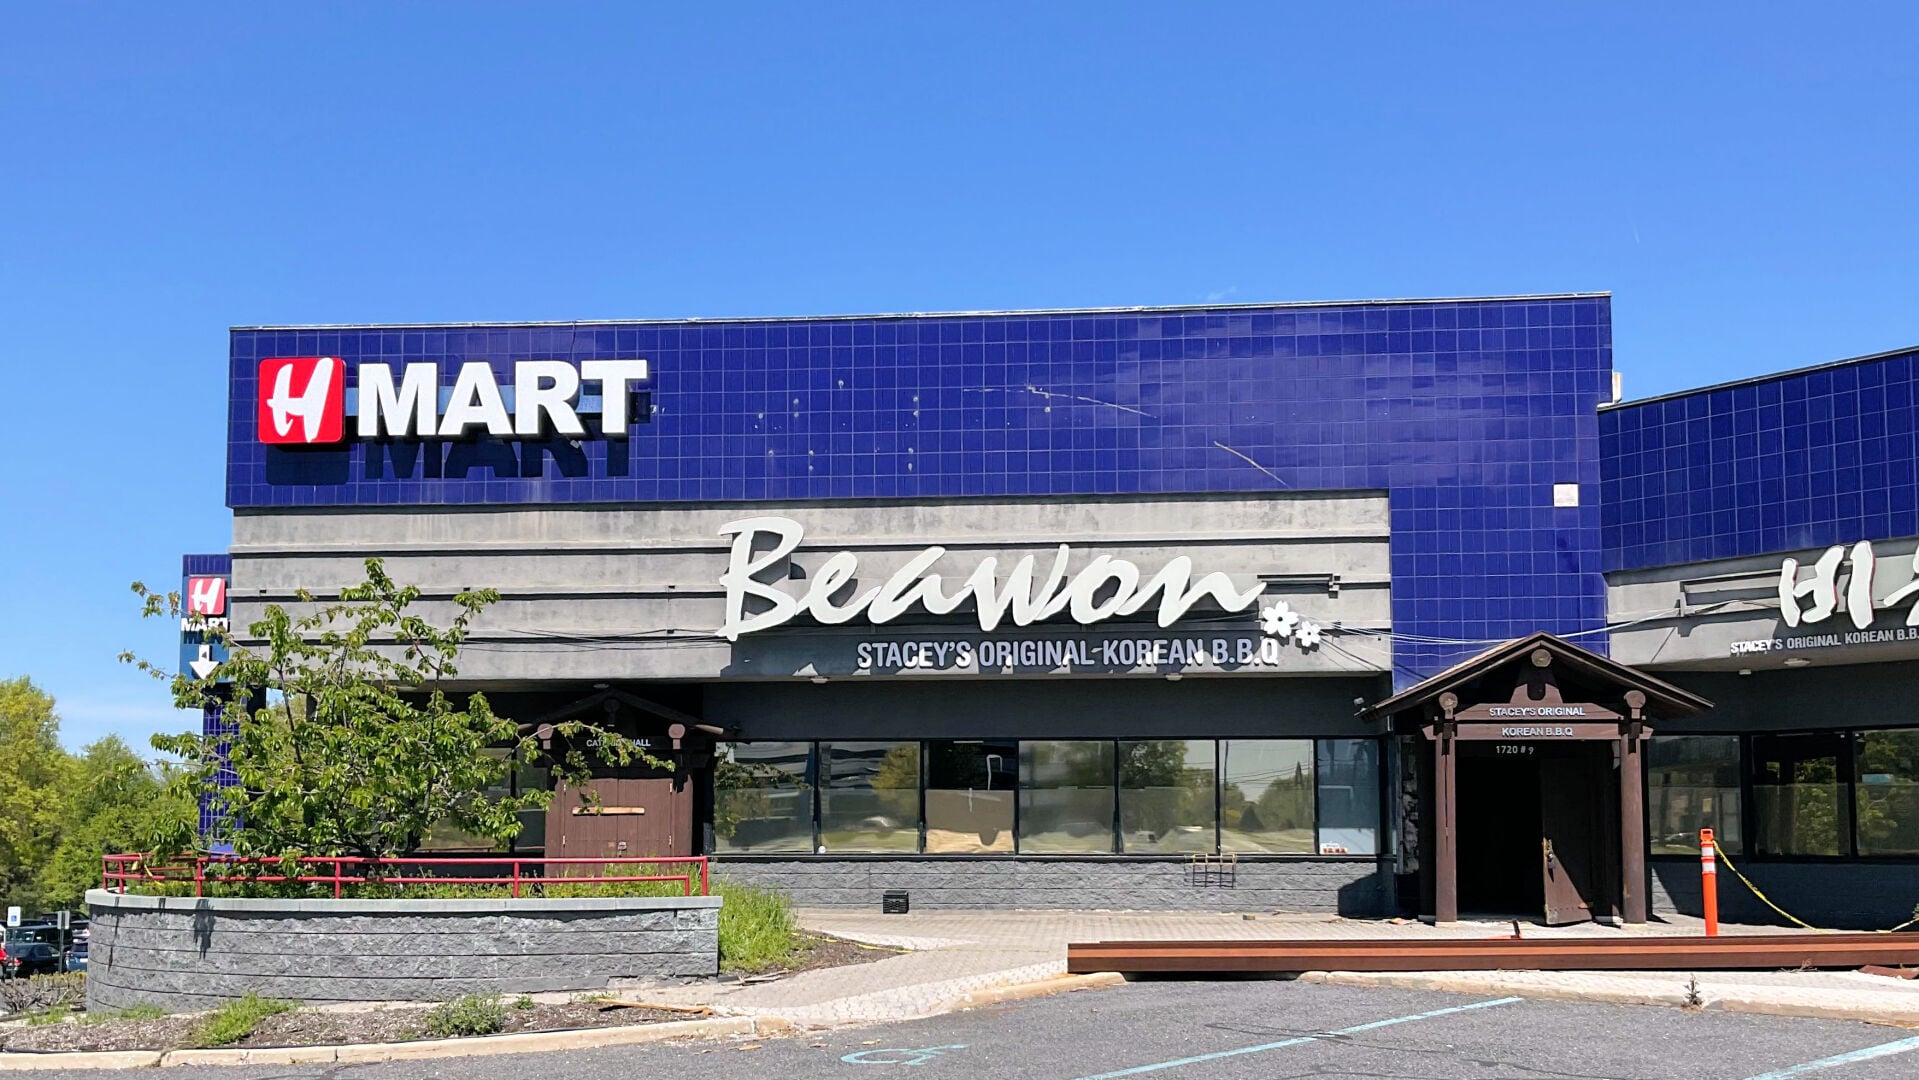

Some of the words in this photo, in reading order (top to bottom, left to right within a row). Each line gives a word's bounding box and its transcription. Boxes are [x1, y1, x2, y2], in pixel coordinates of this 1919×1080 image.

[267, 357, 333, 443] H
[358, 360, 648, 437] MART
[715, 516, 1266, 641] Beawon
[191, 577, 222, 615] H
[857, 641, 971, 668] STACEY'S
[979, 639, 1095, 667] ORIGINAL
[1102, 638, 1204, 666] KOREAN
[1212, 638, 1279, 665] B.B.Q
[1730, 638, 1783, 654] STACEY'S
[1787, 634, 1841, 649] ORIGINAL
[1845, 629, 1893, 645] KOREAN
[1489, 707, 1536, 717] STACEY'S
[1537, 706, 1586, 716] ORIGINAL
[1502, 727, 1544, 736] KOREAN
[1545, 727, 1574, 736] B.B.Q
[1496, 745, 1518, 754] 1720
